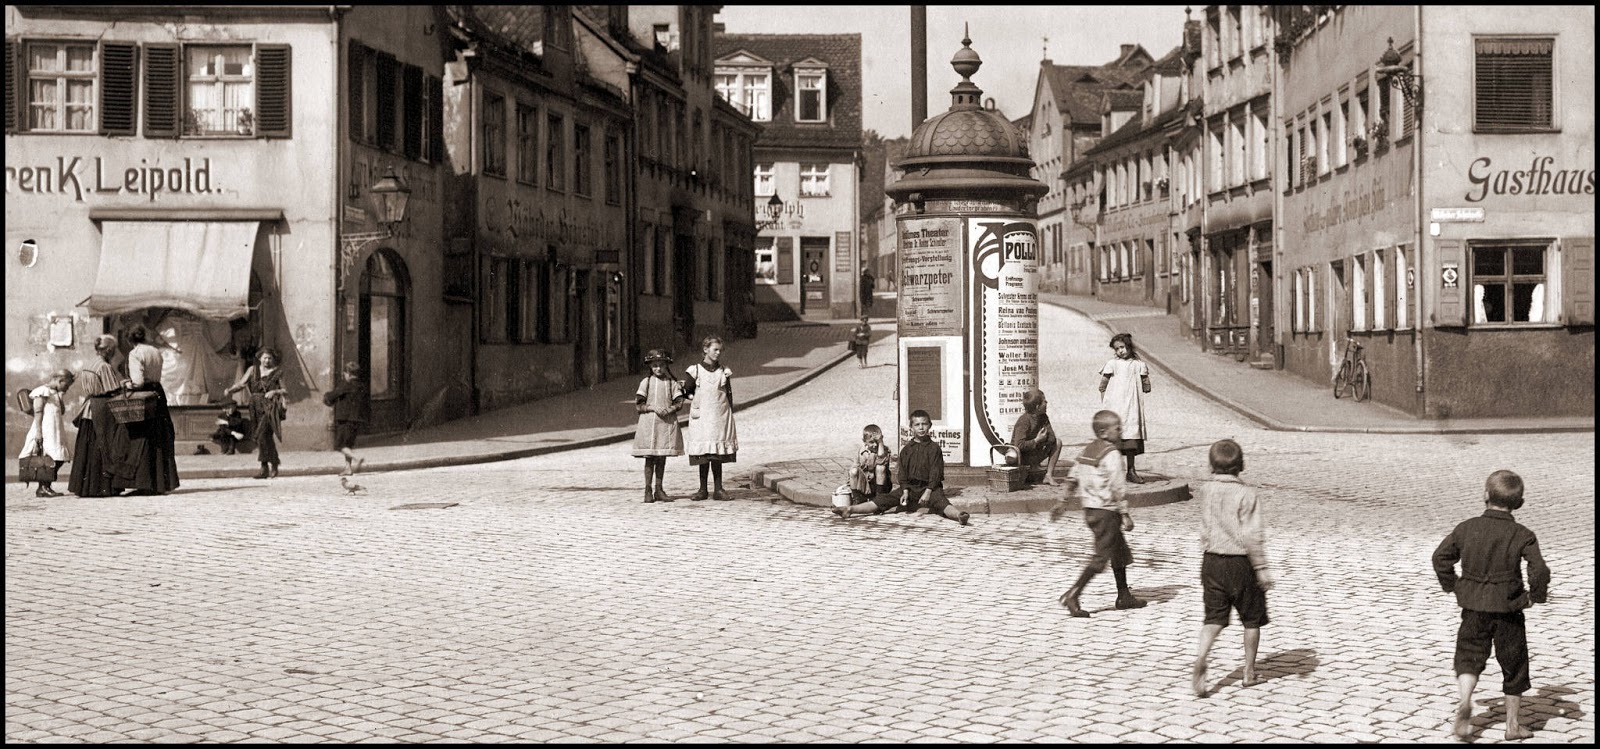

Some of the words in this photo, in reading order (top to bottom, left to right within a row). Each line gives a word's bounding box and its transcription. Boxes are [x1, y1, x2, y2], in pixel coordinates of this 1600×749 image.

[95, 156, 222, 201] Leipold.
[1464, 156, 1595, 203] Gasthaus
[921, 228, 949, 238] Theater
[938, 429, 961, 439] reines
